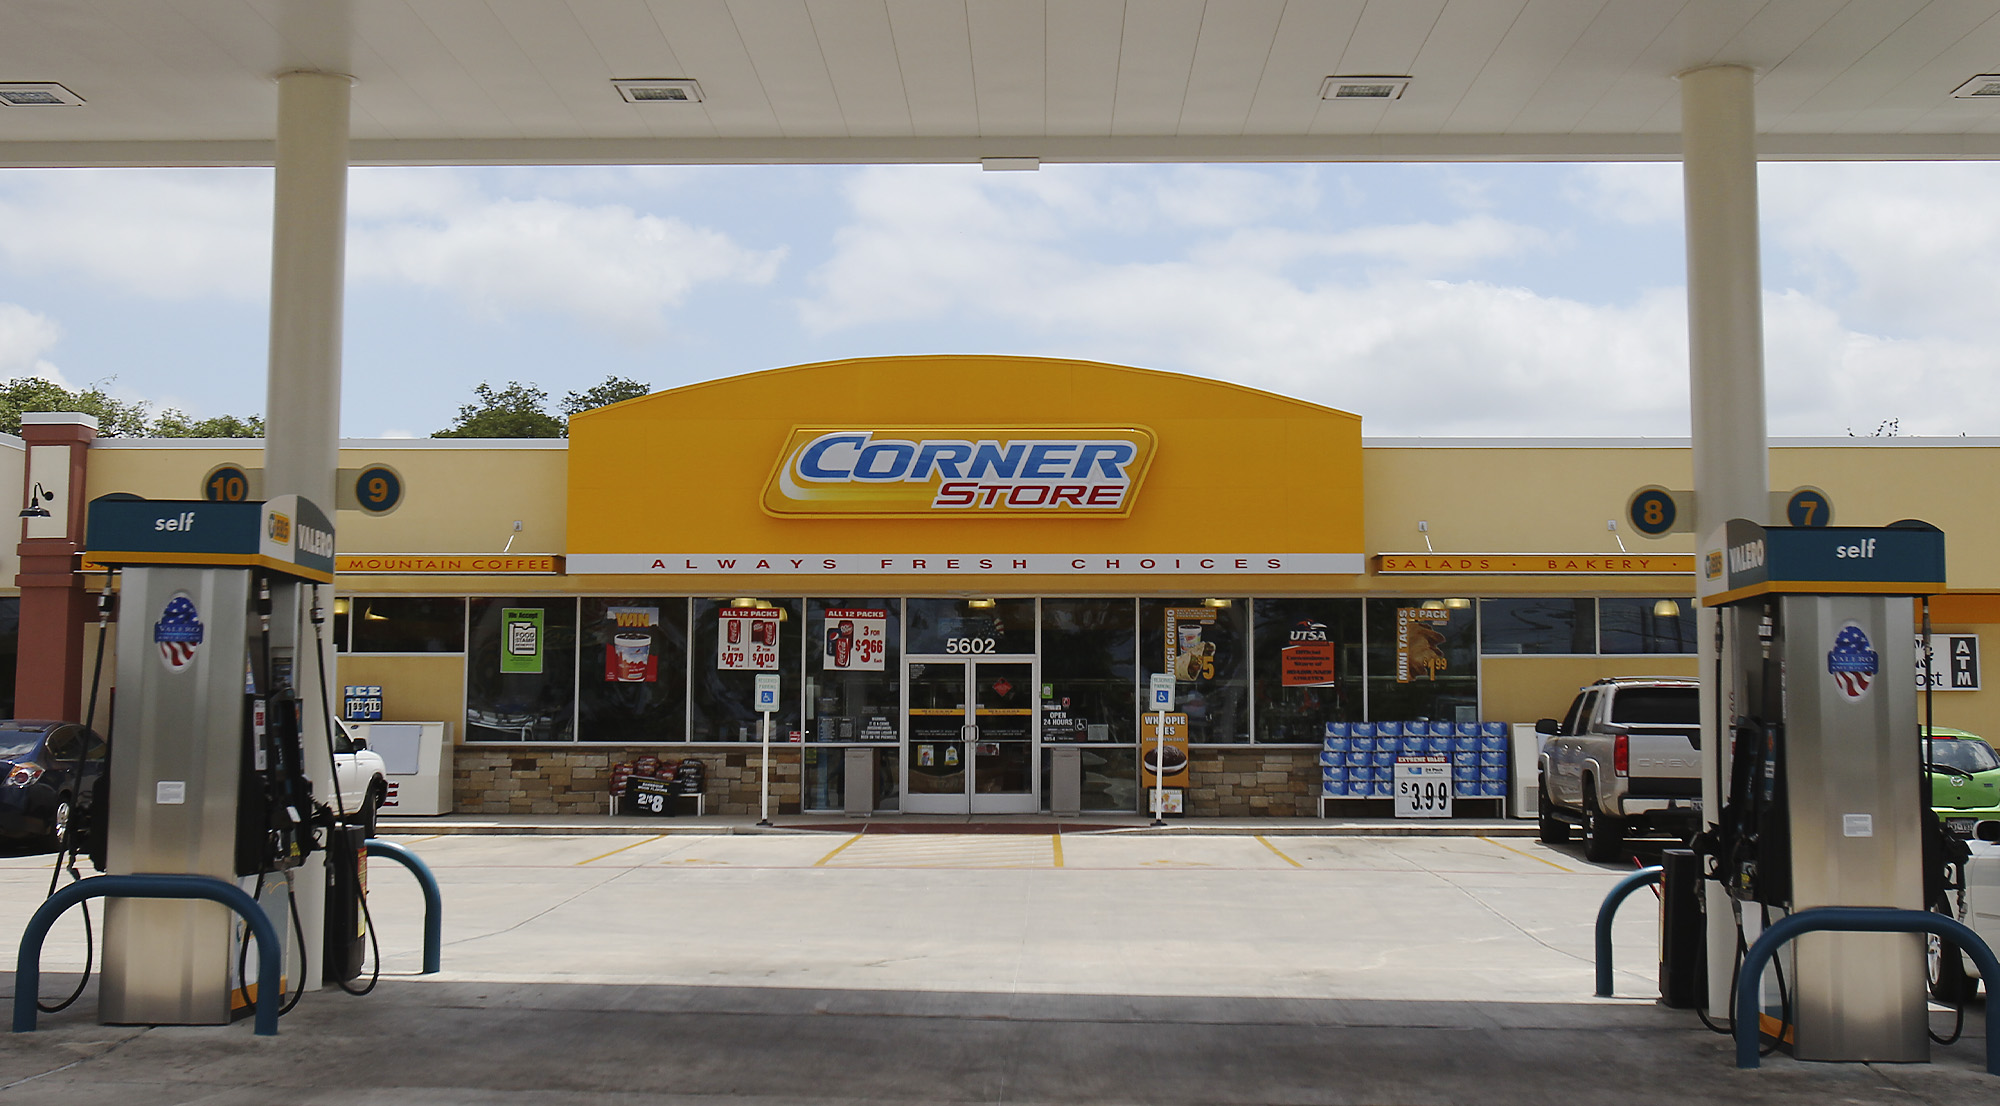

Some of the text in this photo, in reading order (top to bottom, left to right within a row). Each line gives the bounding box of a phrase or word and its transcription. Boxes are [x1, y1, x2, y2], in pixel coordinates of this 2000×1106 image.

[800, 436, 1133, 479] CORNER
[212, 477, 244, 501] 10
[368, 478, 388, 503] 9
[936, 482, 1124, 505] STORE
[1643, 500, 1664, 525] 8
[1800, 501, 1818, 526] 7
[154, 512, 195, 532] self
[297, 524, 334, 559] VALERO
[1836, 538, 1876, 559] self
[651, 558, 1282, 569] ALWAYS FRESH CHOICES
[1728, 538, 1765, 574] VALERO
[350, 559, 549, 570] MOUNTAIN COFFEE
[1386, 559, 1651, 570] SALADS BAKERY
[615, 612, 650, 628] WIN
[1409, 609, 1448, 619] 6 PACK
[863, 625, 869, 636] 3
[1290, 630, 1327, 641] UTSA
[946, 637, 996, 654] 5602
[1167, 609, 1175, 676] UNCH COMBO
[1399, 609, 1408, 681] MINI TACOS
[721, 652, 744, 668] $479
[752, 653, 776, 668] $400
[1955, 640, 1972, 686] ATM
[1915, 671, 1943, 686] ost
[345, 686, 381, 696] ICE
[1043, 718, 1073, 726] 24 HOURS
[1049, 711, 1067, 719] OPEN
[1144, 715, 1186, 725] WHOPIE
